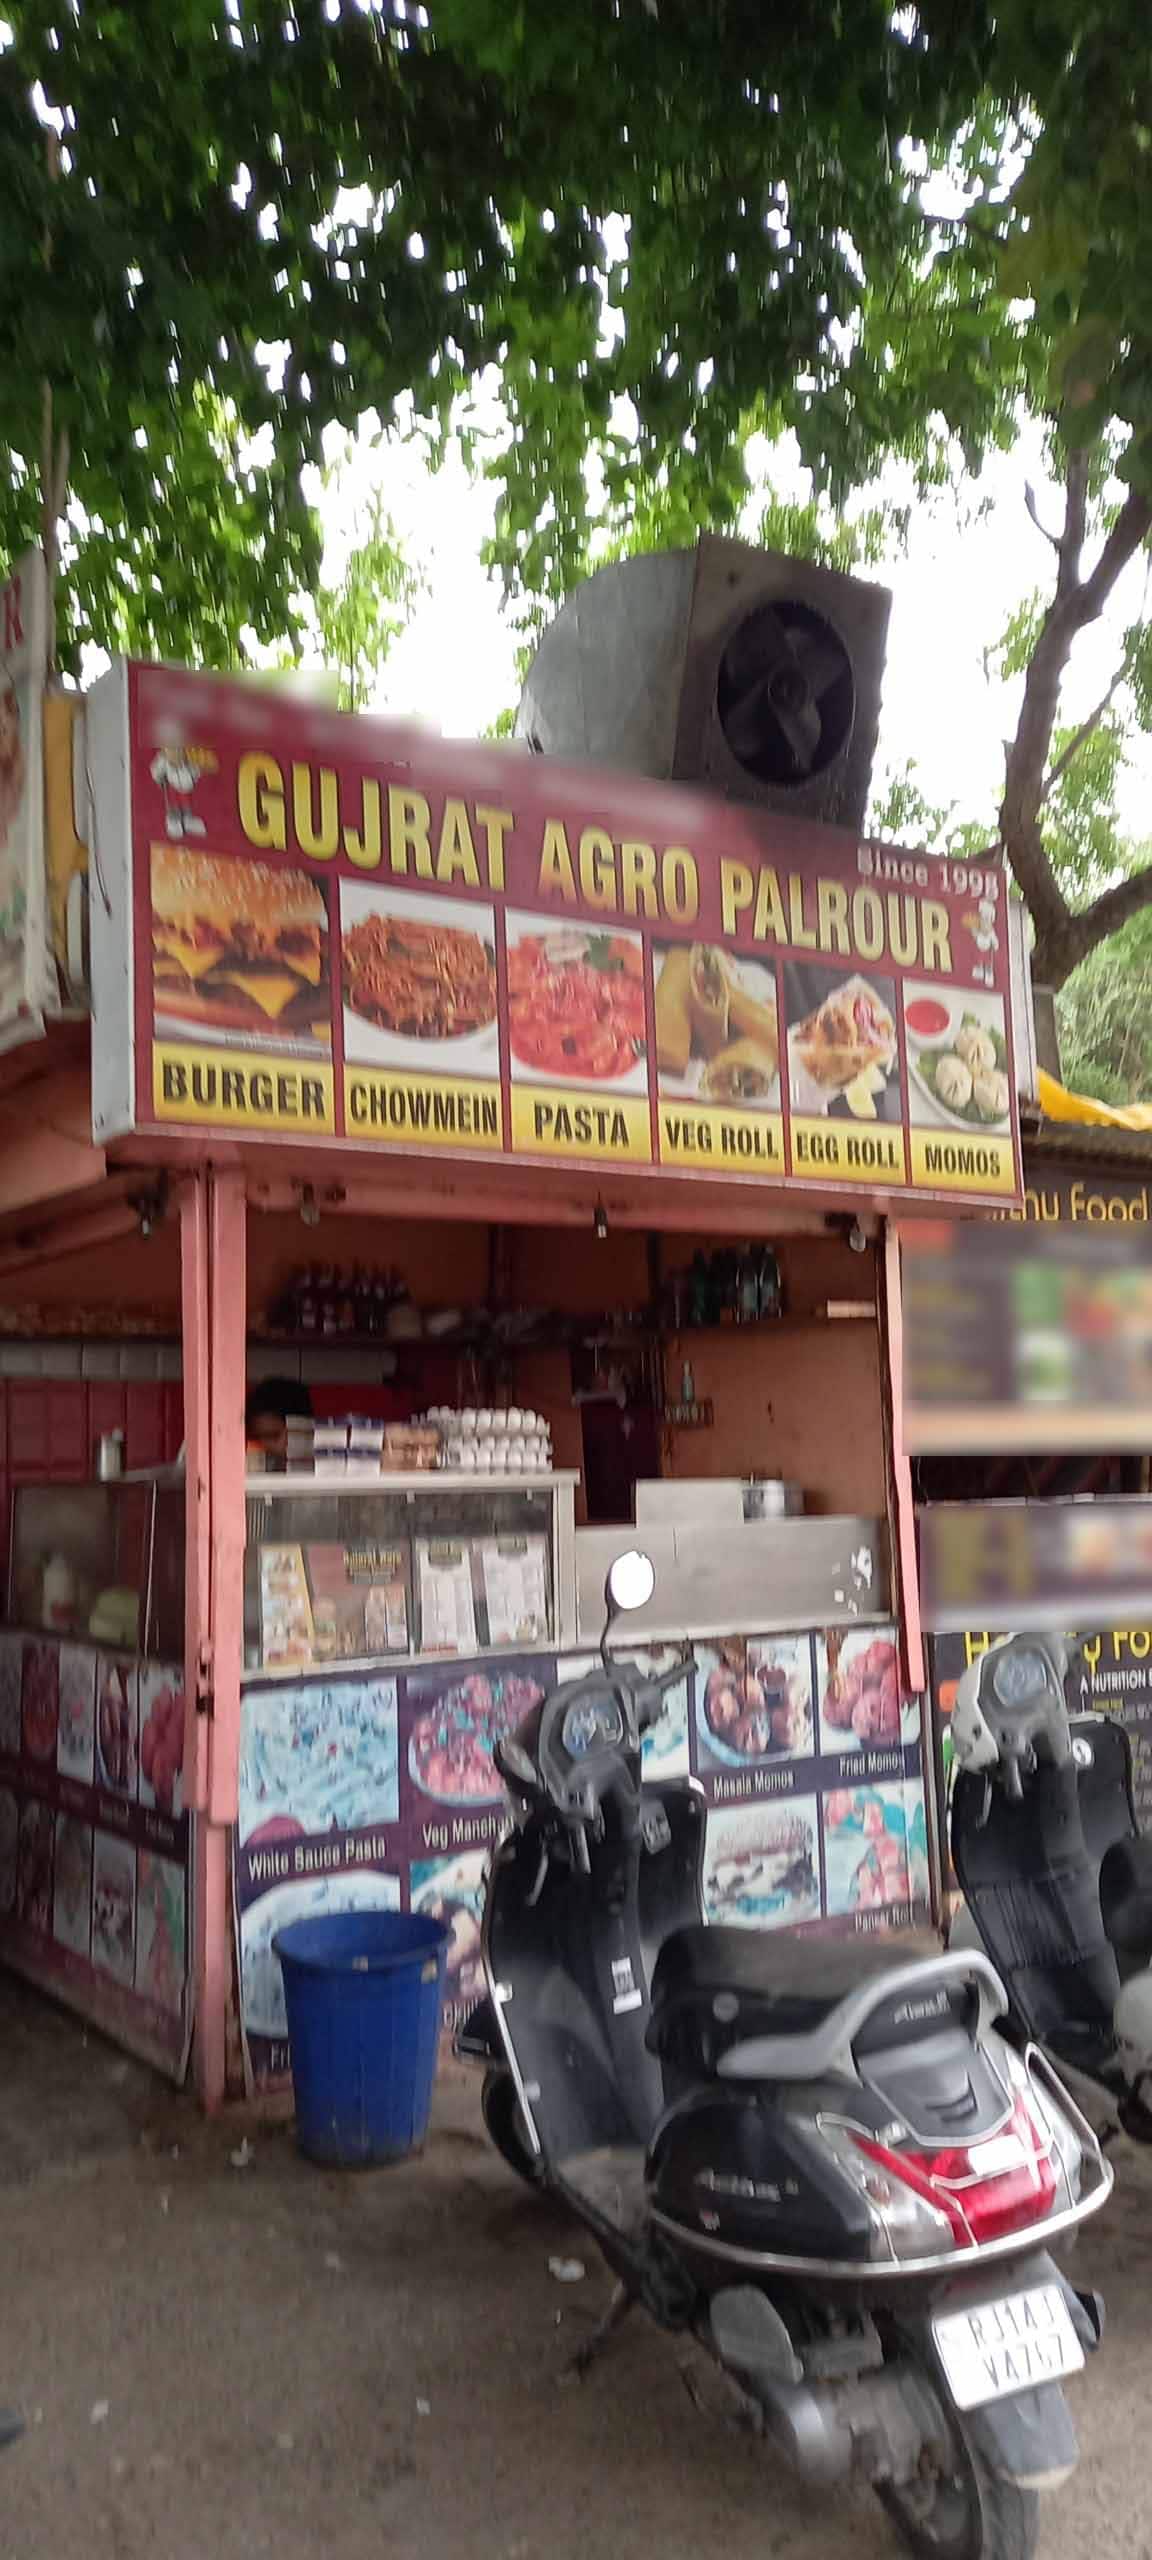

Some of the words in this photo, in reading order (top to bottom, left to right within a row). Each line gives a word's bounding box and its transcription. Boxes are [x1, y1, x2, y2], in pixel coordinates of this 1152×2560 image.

[236, 751, 515, 893] GUJRAT
[538, 818, 700, 925] AGRO
[720, 857, 953, 974] PALROUR
[162, 1060, 327, 1120] BURGER
[350, 1083, 498, 1136] CHOWMEIN
[534, 1102, 629, 1148] PASTA
[665, 1118, 712, 1153] VEG
[721, 1124, 779, 1159] ROLL
[797, 1132, 839, 1166] EGG
[845, 1136, 900, 1169] ROLL
[924, 1146, 1000, 1177] MOMOS
[1091, 1669, 1146, 1695] NUTRITION
[422, 1821, 448, 1850] Veg
[248, 1848, 289, 1883] White
[294, 1844, 340, 1872] Sauce
[345, 1835, 385, 1864] Pasta
